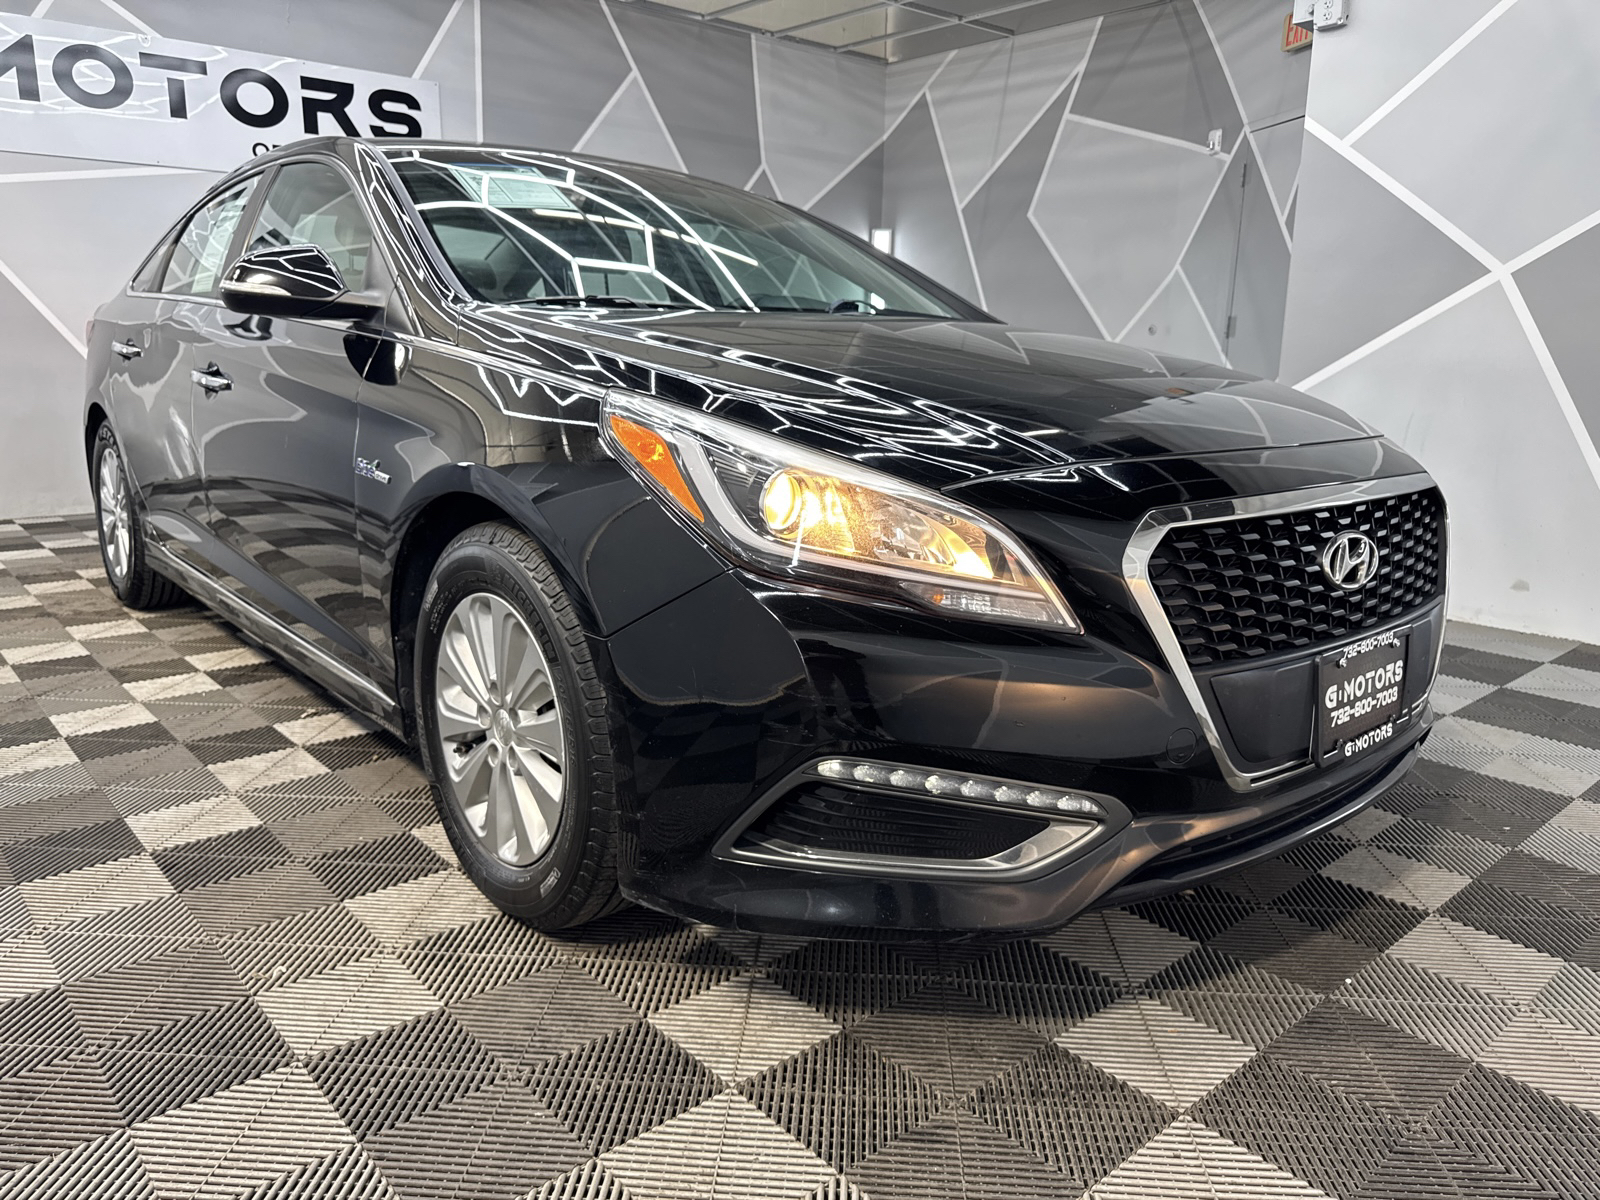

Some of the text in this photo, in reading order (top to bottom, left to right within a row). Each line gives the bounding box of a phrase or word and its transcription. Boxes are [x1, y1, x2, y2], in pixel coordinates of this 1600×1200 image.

[502, 572, 557, 660] MICHELIN
[1343, 632, 1394, 658] 732-800-7003
[1330, 686, 1398, 728] 732-800-7003
